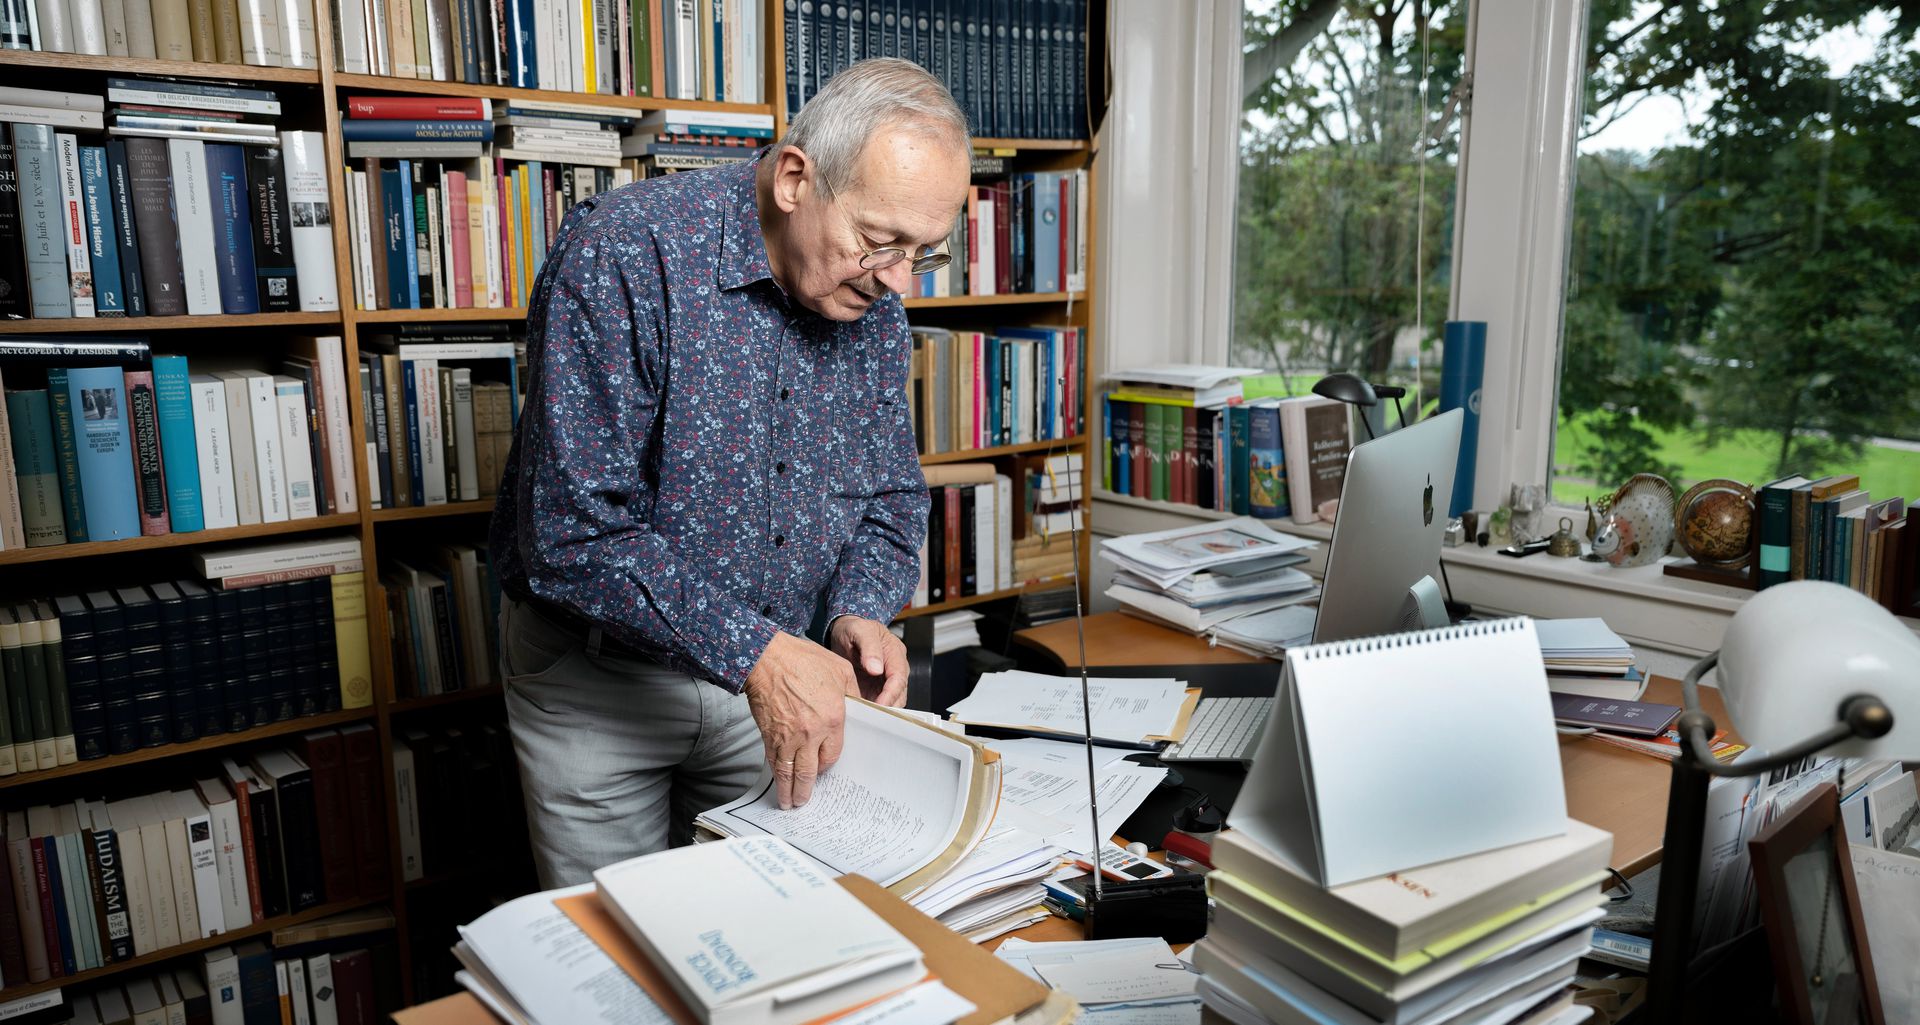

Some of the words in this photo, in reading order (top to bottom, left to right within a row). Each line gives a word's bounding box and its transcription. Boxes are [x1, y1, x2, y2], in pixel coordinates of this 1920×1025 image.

[357, 103, 375, 114] bup
[63, 139, 73, 166] Modern
[28, 157, 41, 181] siècle
[94, 150, 103, 178] Routledge
[66, 167, 76, 197] Judaism
[88, 185, 97, 194] in
[267, 176, 276, 189] The
[33, 200, 45, 208] le
[119, 195, 127, 204] du
[257, 183, 268, 212] JEWISH
[269, 190, 279, 212] Oxford
[36, 211, 45, 220] et
[88, 195, 101, 225] Jewish
[121, 205, 130, 229] histoire
[36, 222, 50, 241] Juifs
[261, 214, 272, 245] STUDIES
[39, 242, 50, 257] Les
[92, 226, 103, 257] History
[125, 236, 133, 248] Art
[273, 246, 283, 255] of
[77, 348, 119, 356] HASIDISM
[132, 393, 144, 417] JODEN
[136, 418, 146, 429] IN
[142, 391, 156, 444] GESCHIEDENIS
[137, 428, 150, 474] NEDERLAND
[148, 445, 157, 461] VAN
[150, 462, 159, 473] DE
[264, 573, 287, 583] THE
[94, 833, 121, 912] JUDAISM
[110, 920, 125, 928] THE
[109, 928, 129, 937] WEB
